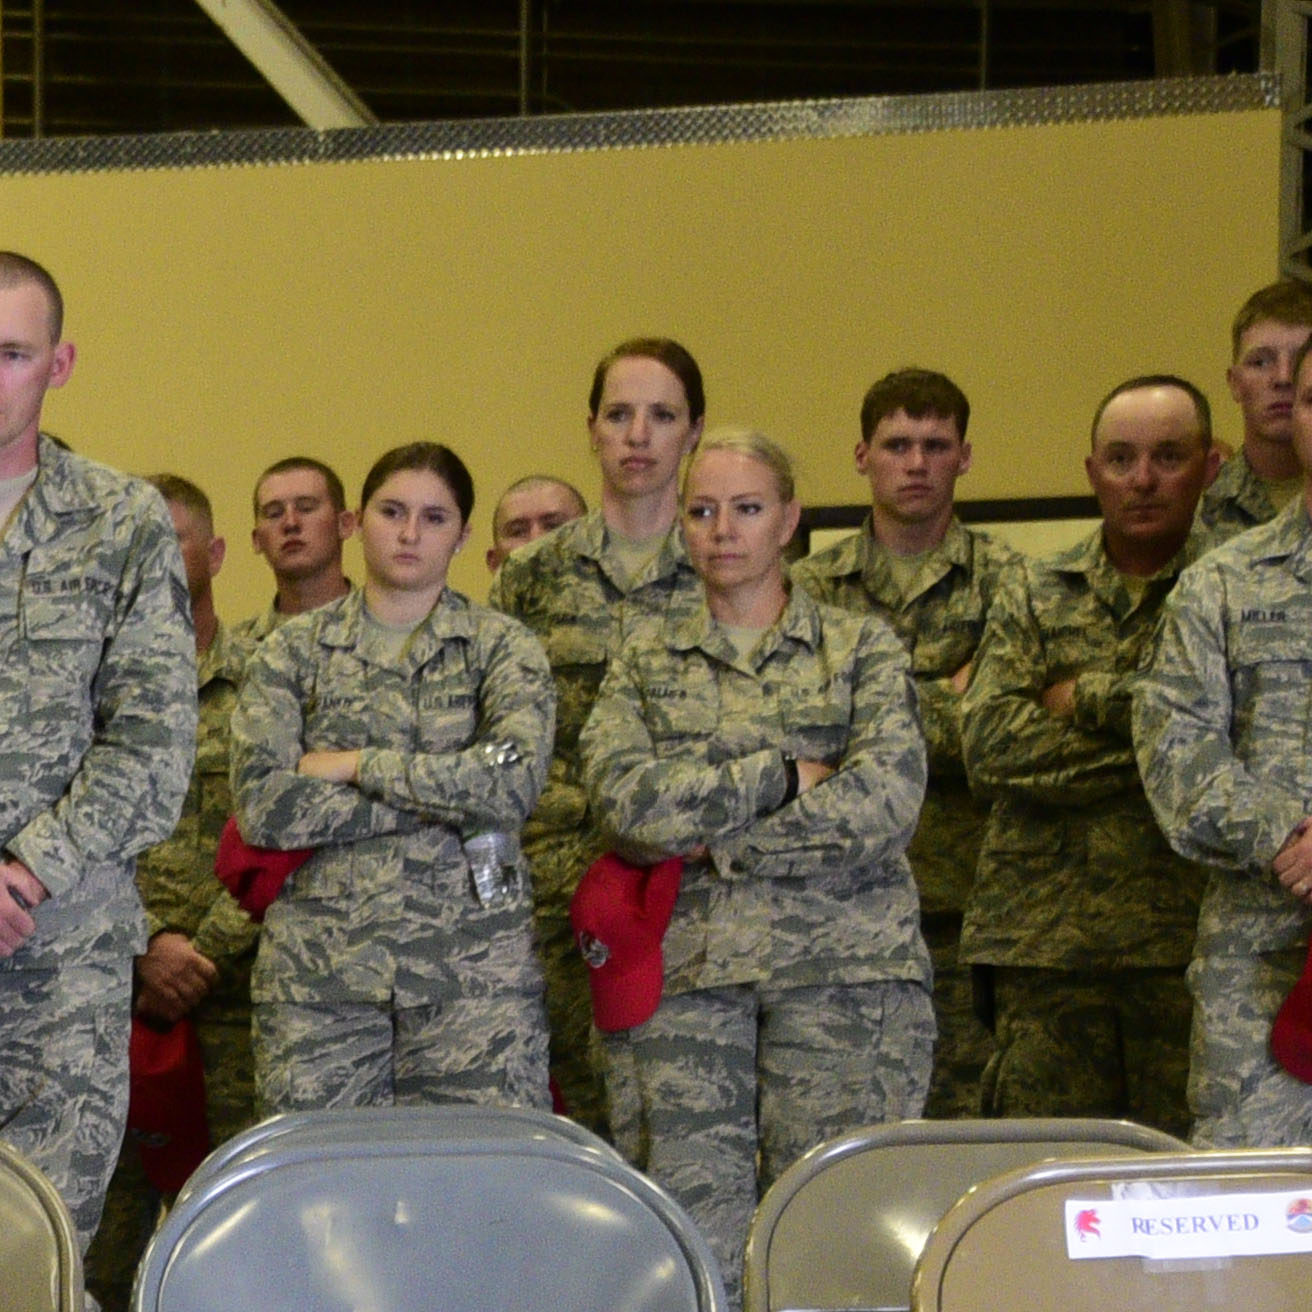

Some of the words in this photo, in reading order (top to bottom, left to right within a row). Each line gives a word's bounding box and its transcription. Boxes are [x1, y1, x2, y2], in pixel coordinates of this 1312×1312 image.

[60, 577, 81, 593] AIR
[1240, 607, 1286, 623] MILLER
[1131, 1212, 1260, 1237] RESERVED
